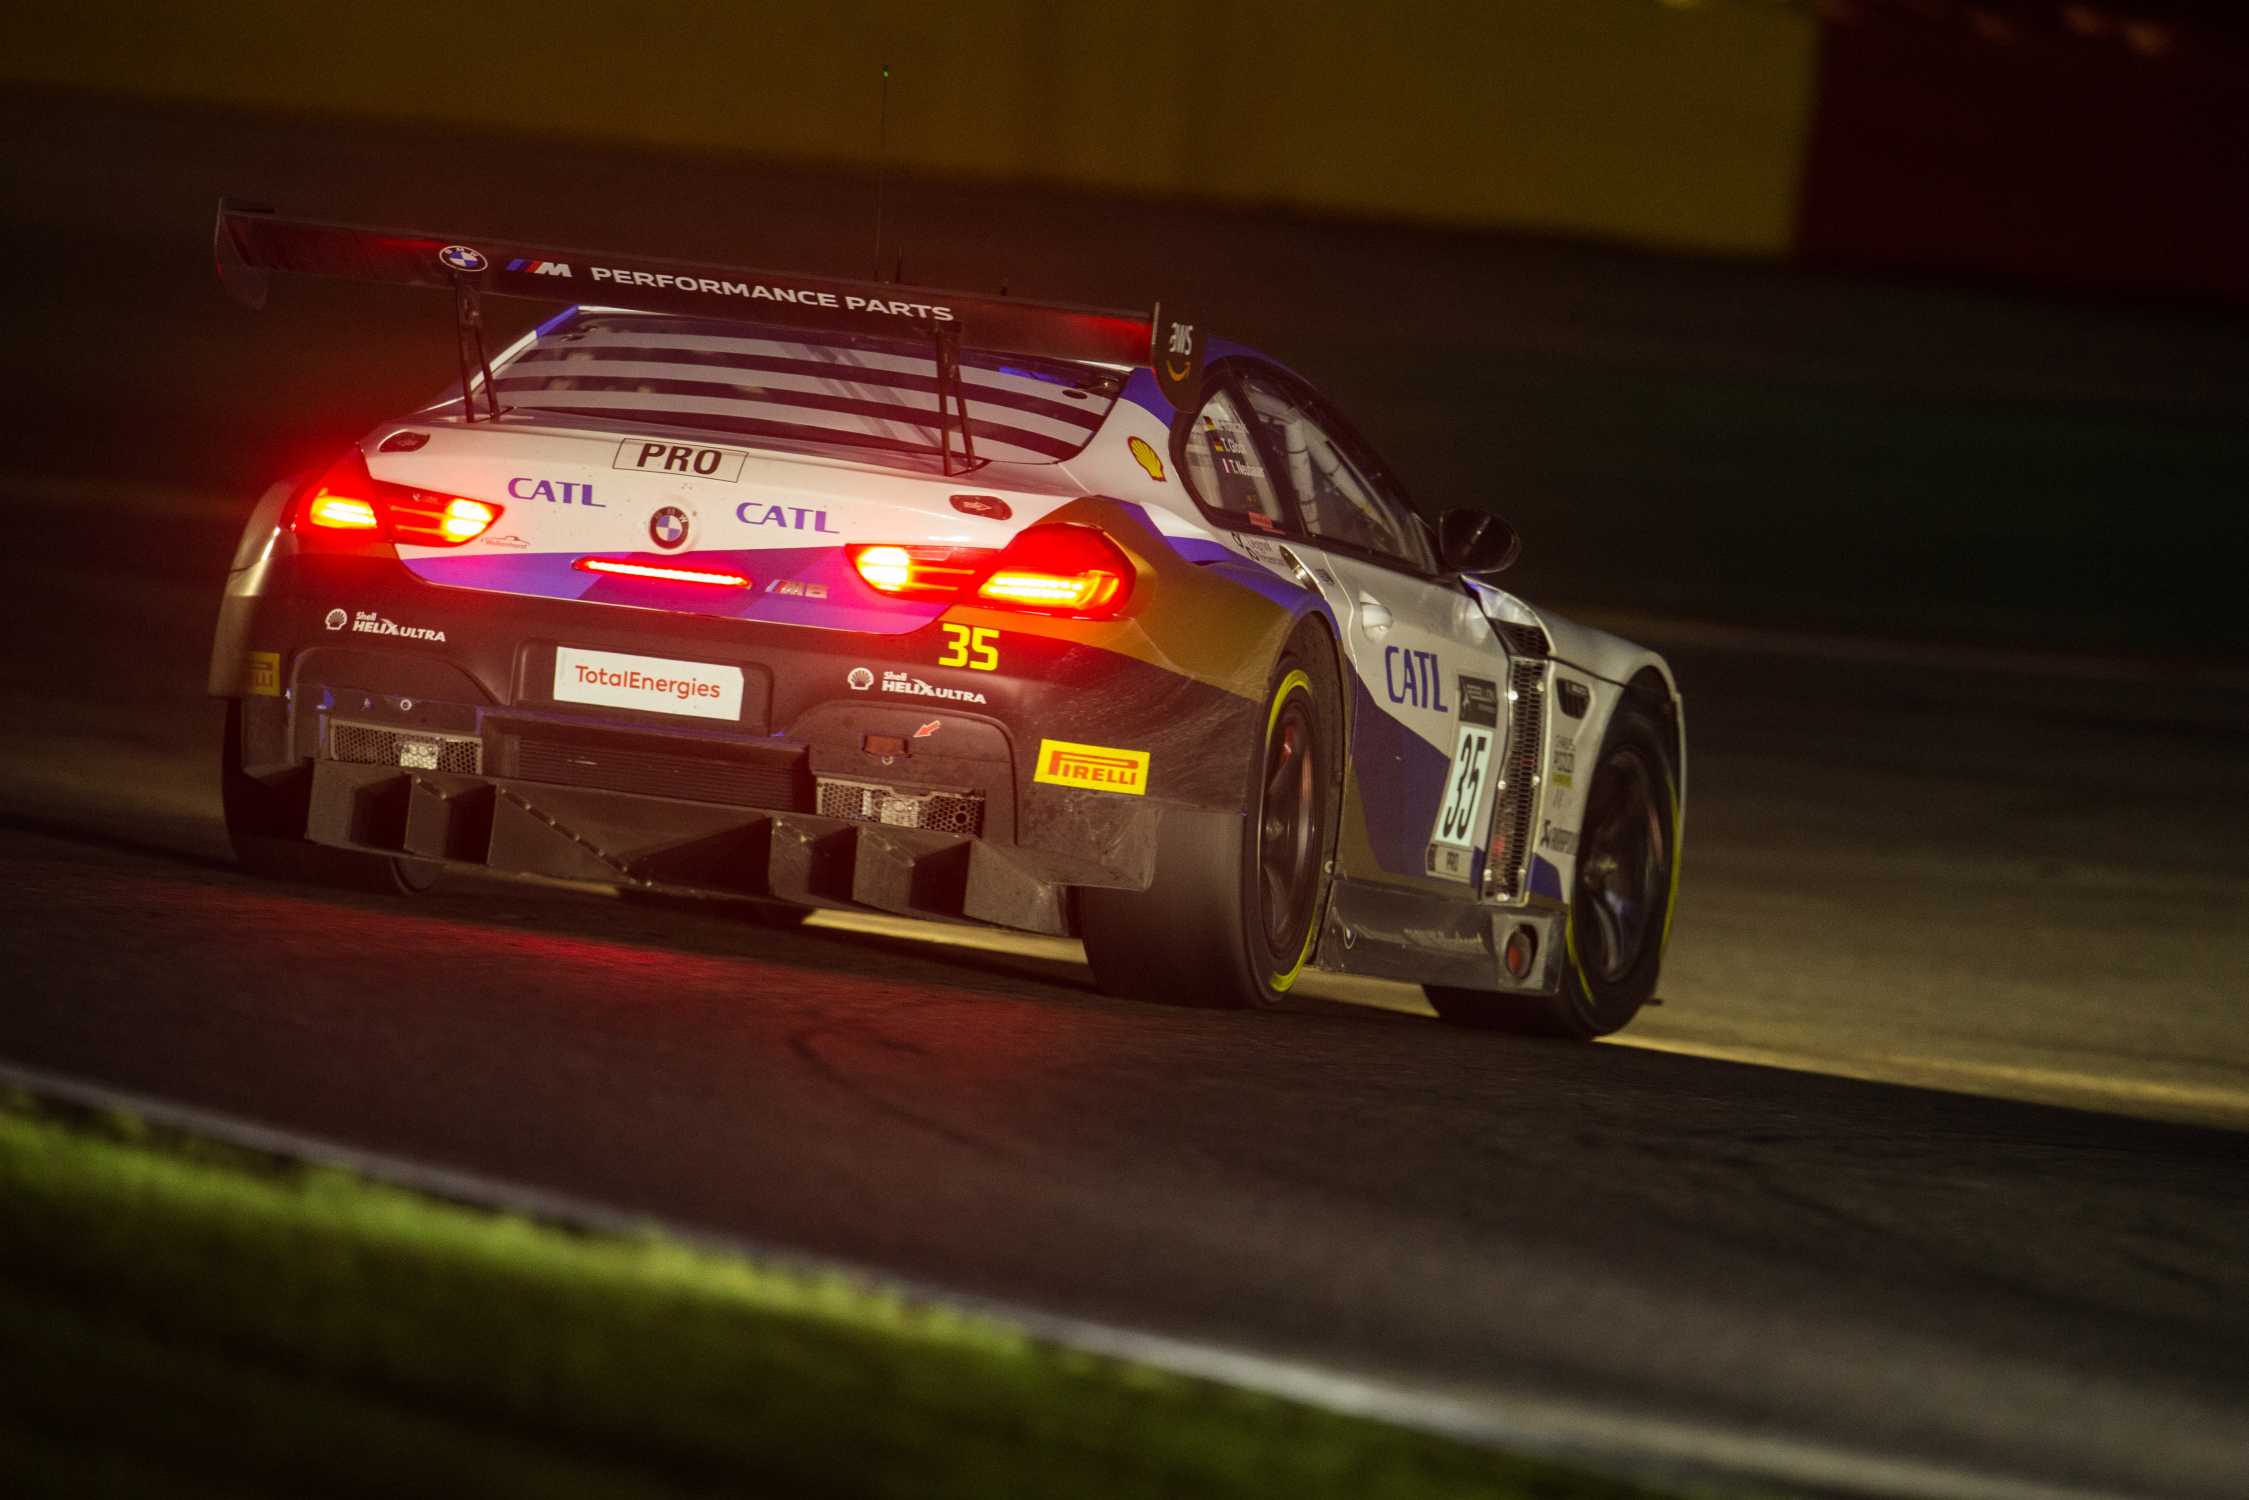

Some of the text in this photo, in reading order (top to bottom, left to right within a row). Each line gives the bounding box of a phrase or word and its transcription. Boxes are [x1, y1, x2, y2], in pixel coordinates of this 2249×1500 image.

[590, 267, 839, 308] PERFORMANCE
[845, 296, 954, 322] PARTS
[636, 442, 723, 476] PRO
[508, 476, 606, 507] CATL
[736, 502, 840, 534] CATL
[938, 623, 1000, 671] 35
[575, 664, 720, 699] TotalEnergies
[1385, 646, 1448, 713] CATL
[1048, 750, 1139, 785] PIRELLI
[1442, 733, 1487, 840] 35
